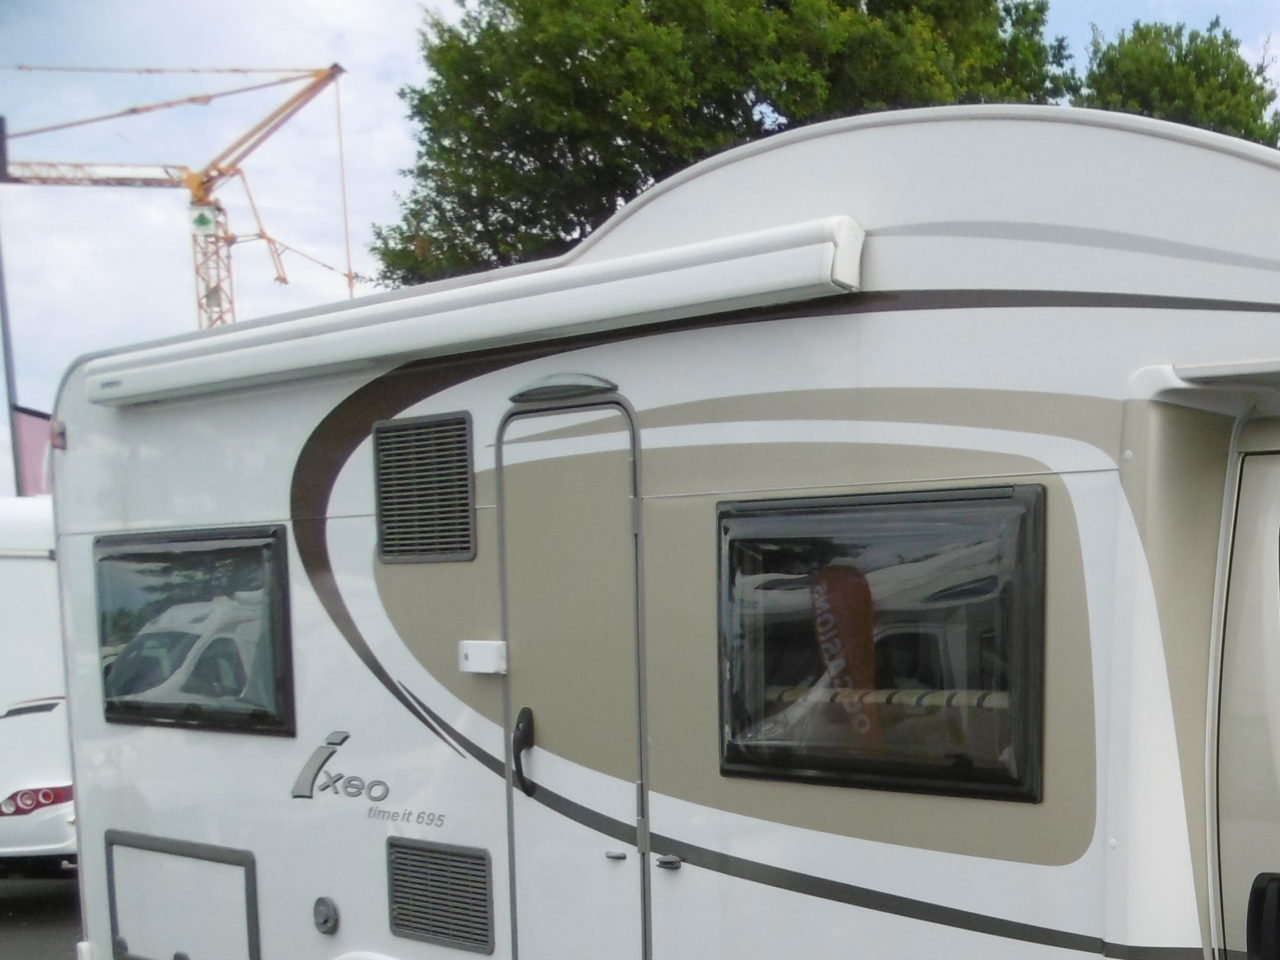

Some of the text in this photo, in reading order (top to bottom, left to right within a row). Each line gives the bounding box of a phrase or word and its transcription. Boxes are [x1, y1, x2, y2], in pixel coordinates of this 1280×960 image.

[291, 731, 390, 802] ixeo
[367, 806, 446, 828] time it 695
